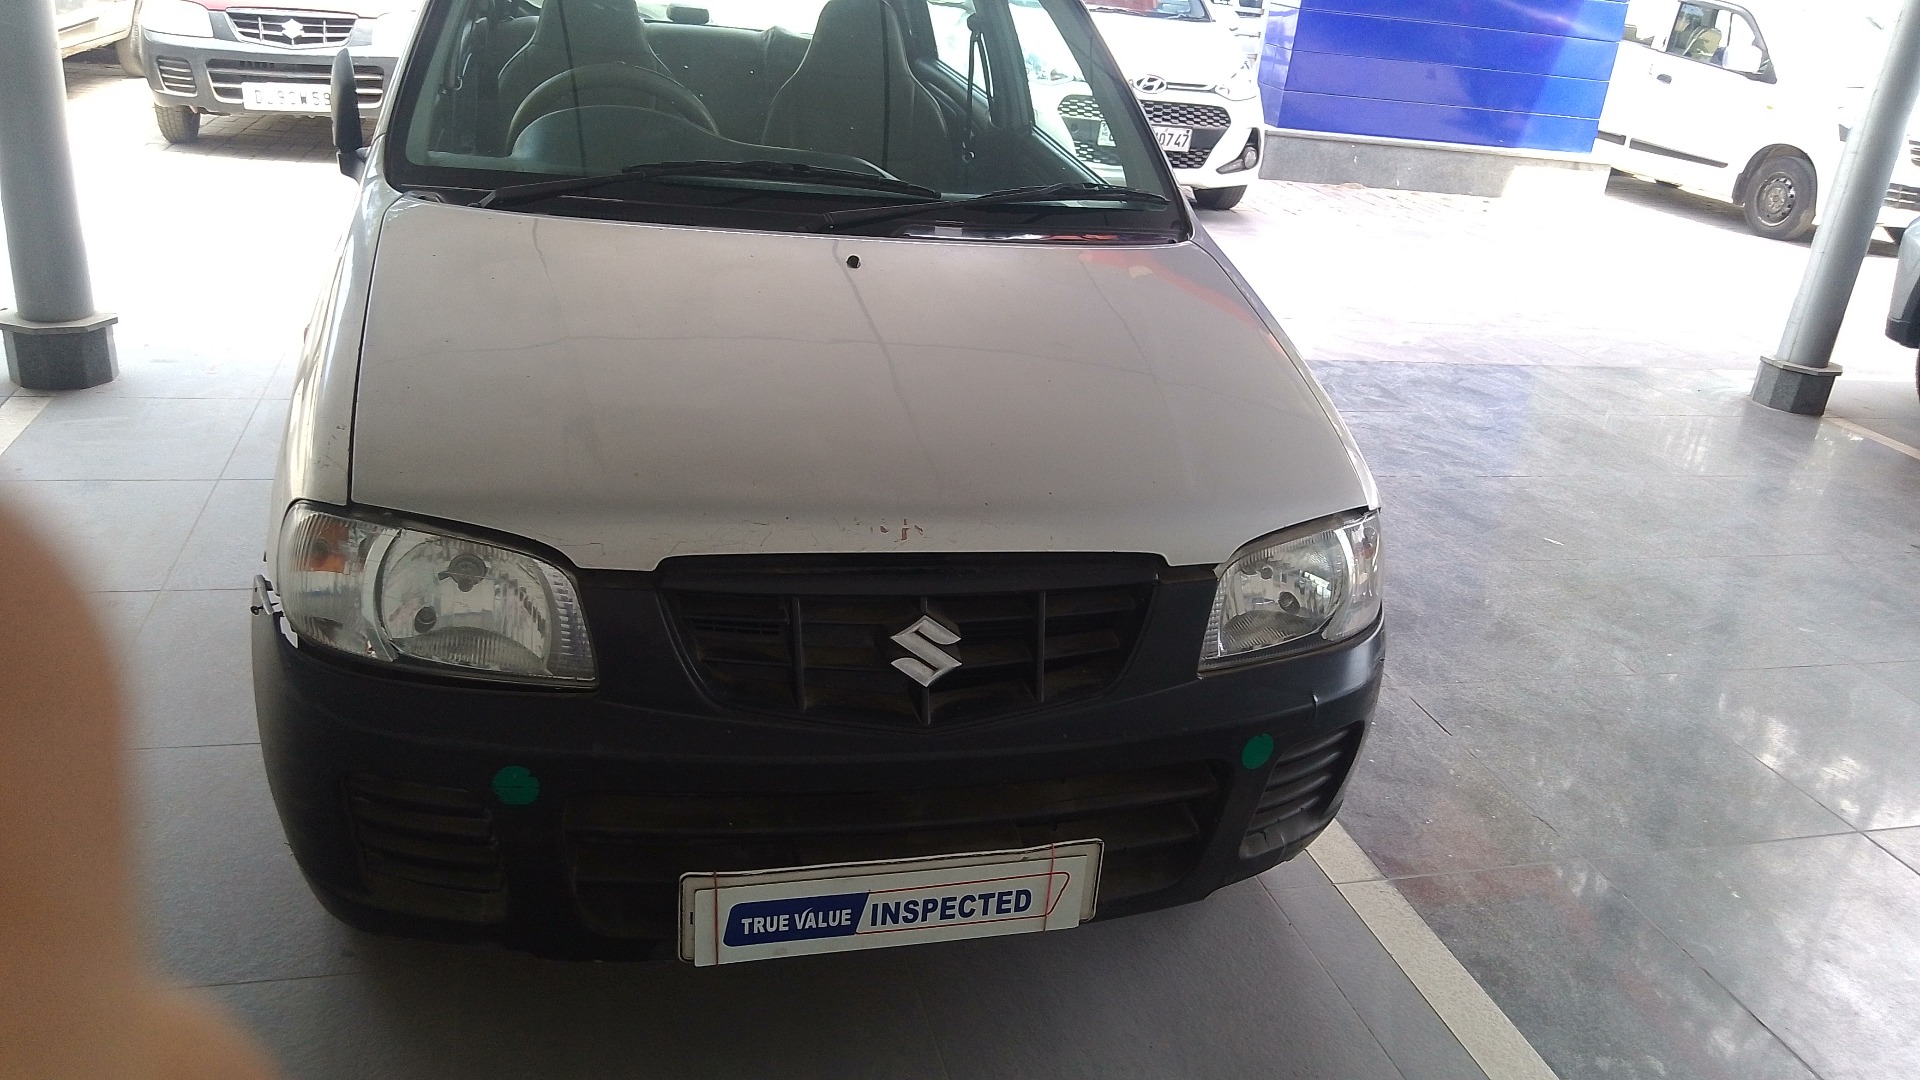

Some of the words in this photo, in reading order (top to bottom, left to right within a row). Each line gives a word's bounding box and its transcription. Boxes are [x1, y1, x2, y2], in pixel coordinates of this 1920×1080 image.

[741, 914, 790, 935] TRUE
[794, 907, 852, 930] VALUE
[870, 889, 1033, 927] INSPECTED
